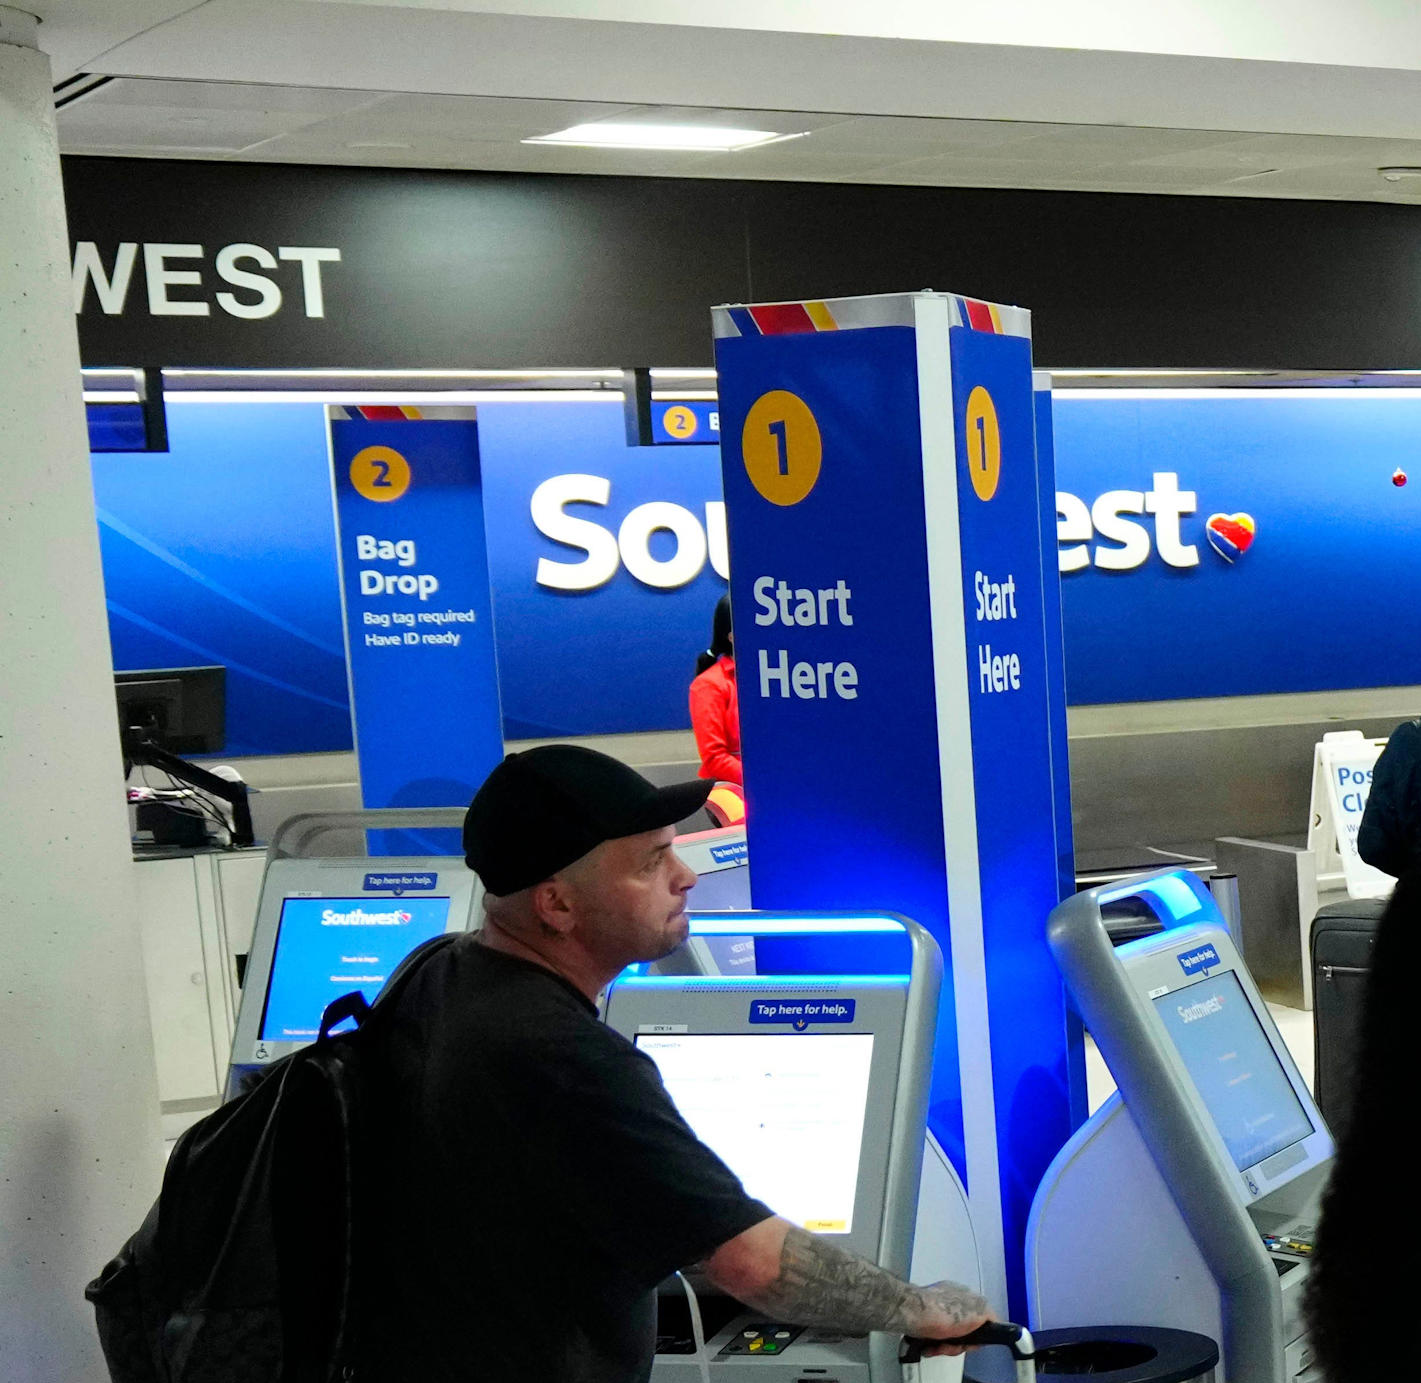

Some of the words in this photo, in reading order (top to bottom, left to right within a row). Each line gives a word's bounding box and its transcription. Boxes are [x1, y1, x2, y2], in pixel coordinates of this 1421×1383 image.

[72, 241, 342, 319] WEST
[769, 420, 790, 476] 1
[371, 460, 393, 487] 2
[356, 535, 417, 567] Bag
[359, 570, 439, 601] Drop
[753, 575, 854, 627] Start
[974, 570, 1017, 621] Start
[363, 612, 391, 627] Bag
[392, 612, 416, 627] tag
[418, 609, 476, 626] required
[365, 633, 401, 647] Have
[403, 632, 420, 645] ID
[422, 630, 461, 647] ready
[758, 649, 858, 700] Here
[978, 644, 1021, 694] Here
[369, 877, 382, 886] Tap
[384, 876, 400, 885] here
[401, 876, 413, 885] for
[321, 908, 400, 926] Southwest
[758, 1005, 776, 1018] Tap
[778, 1004, 804, 1015] here
[804, 1003, 821, 1015] for
[821, 1003, 848, 1017] help.
